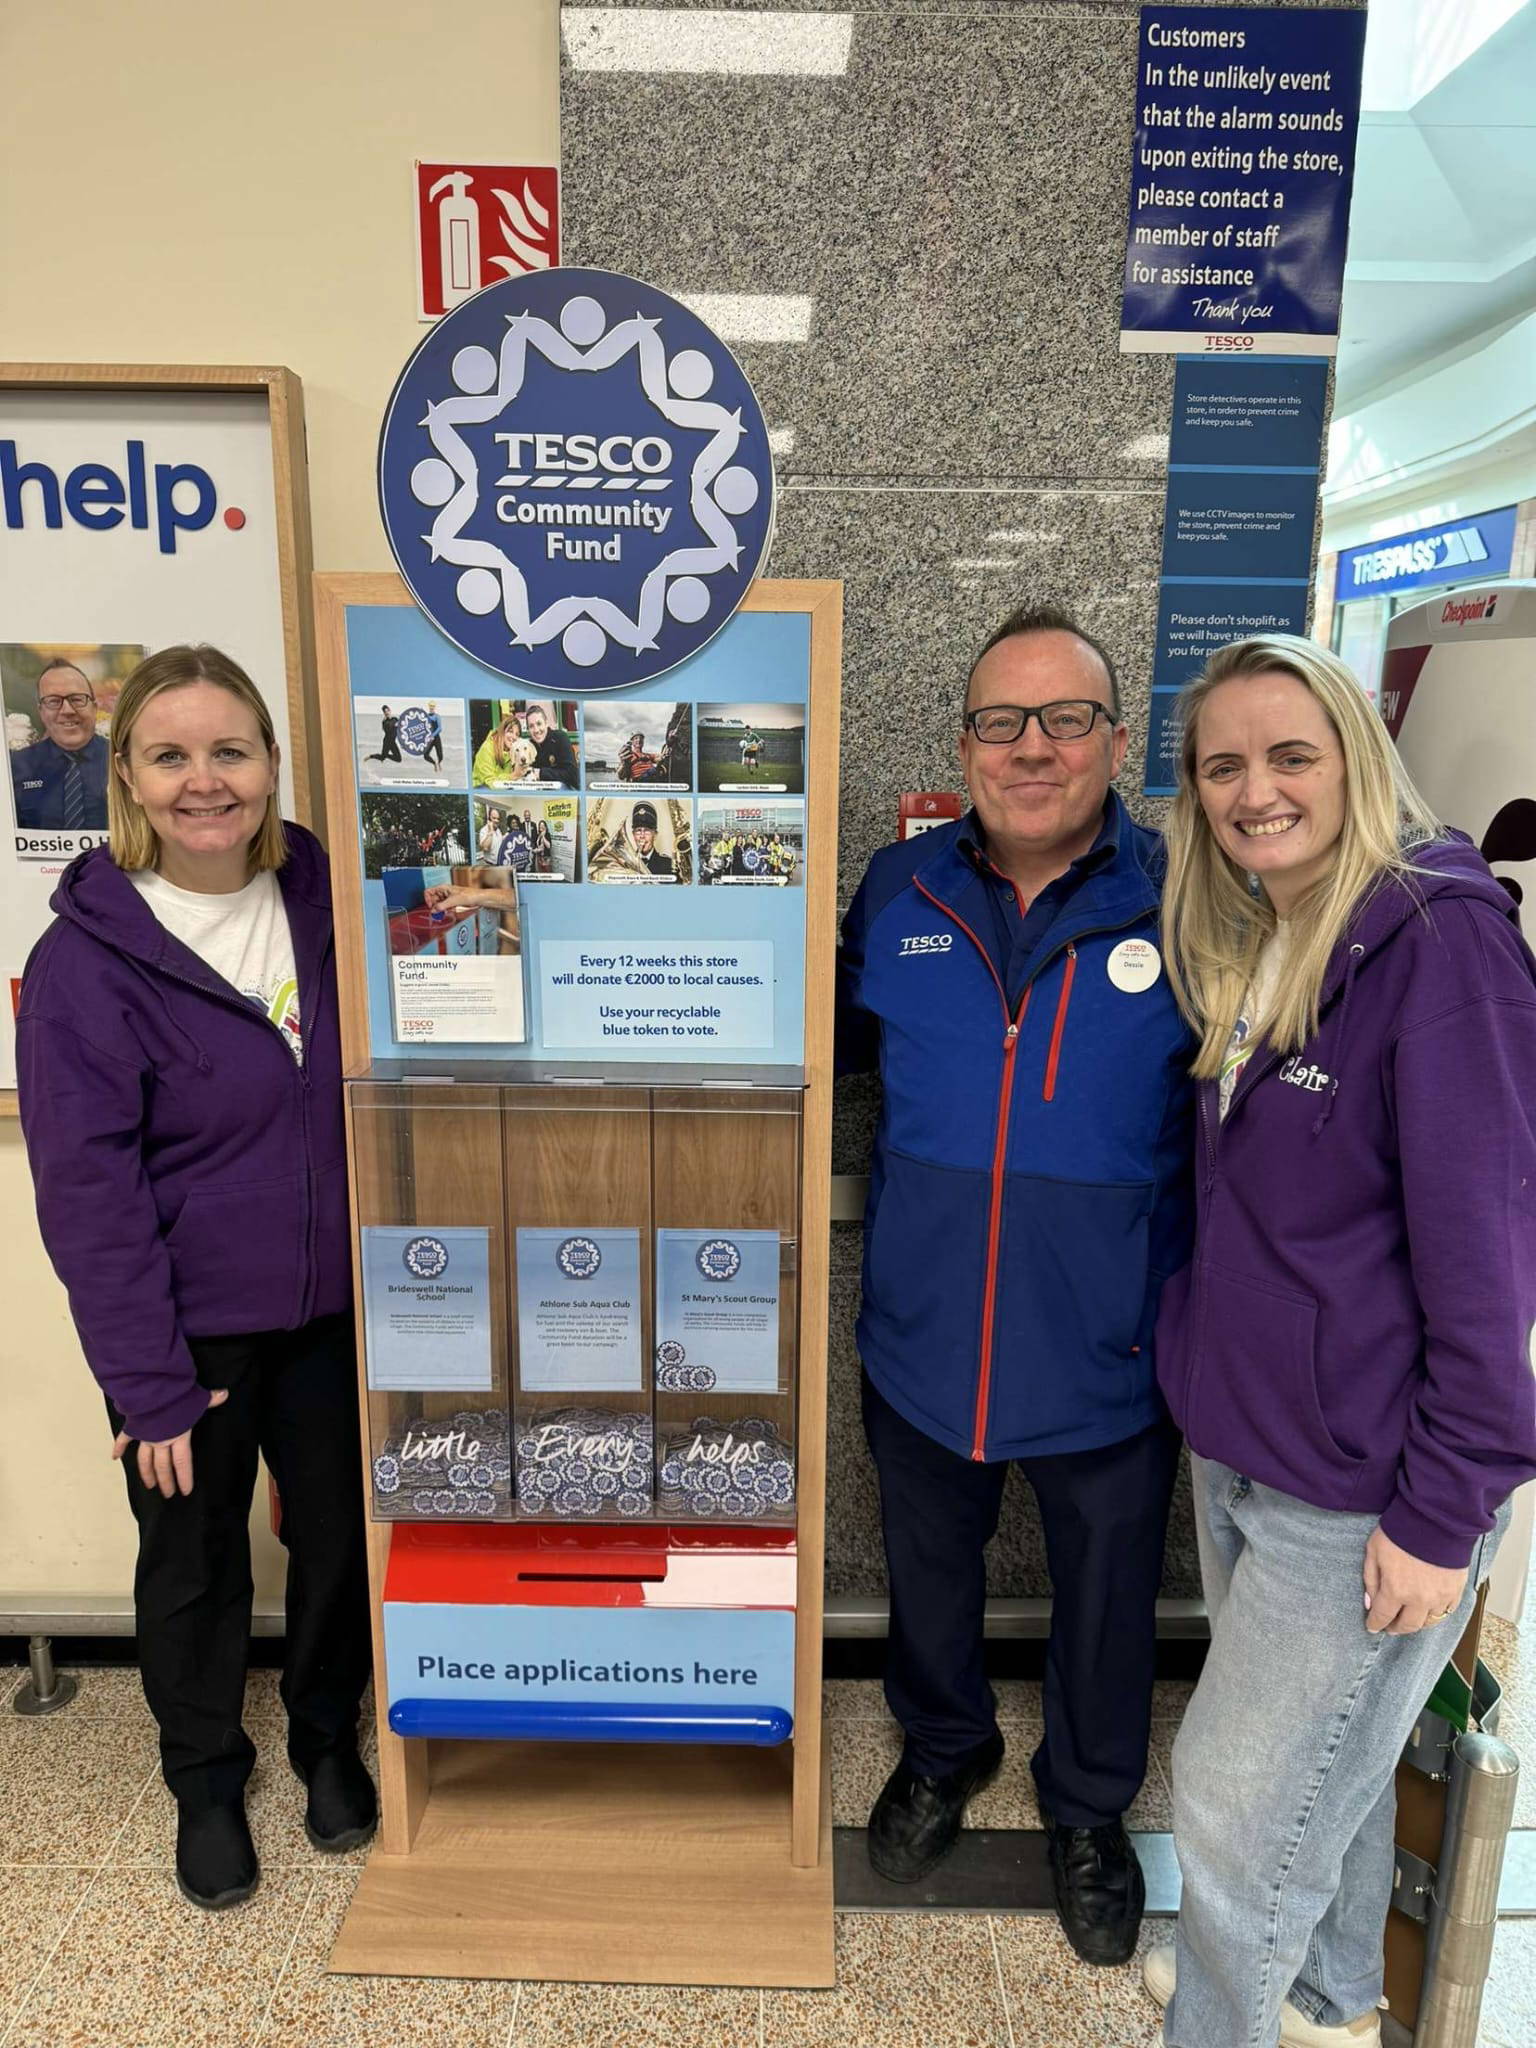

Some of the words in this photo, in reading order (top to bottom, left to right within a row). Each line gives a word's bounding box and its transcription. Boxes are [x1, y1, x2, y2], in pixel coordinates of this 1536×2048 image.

[1148, 24, 1245, 48] Customers
[1146, 64, 1162, 85] In
[1169, 65, 1198, 87] the
[1204, 67, 1275, 94] unlikely
[1280, 71, 1330, 91] event
[1143, 104, 1180, 127] that
[1186, 105, 1215, 128] the
[1220, 107, 1272, 129] alarm
[1278, 109, 1343, 131] sounds
[1141, 148, 1185, 170] upon
[1191, 147, 1252, 174] exiting
[1258, 148, 1288, 170] the
[1293, 151, 1344, 175] store,
[1138, 183, 1194, 209] please
[1200, 187, 1268, 209] contact
[1274, 192, 1283, 208] a
[1135, 224, 1208, 246] member
[1212, 225, 1232, 247] of
[1236, 226, 1280, 247] staff
[1133, 262, 1158, 283] for
[1161, 264, 1253, 285] assistance
[1192, 298, 1237, 320] Thank
[1241, 305, 1272, 324] you
[1205, 336, 1254, 346] TESCO
[1188, 394, 1207, 402] Store
[1209, 395, 1247, 403] detectives
[1249, 396, 1277, 405] operate
[1279, 396, 1286, 404] in
[1187, 407, 1207, 415] store,
[1209, 406, 1215, 414] in
[1217, 406, 1237, 415] order
[1248, 408, 1276, 417] prevent
[1278, 408, 1299, 416] crime
[1202, 418, 1220, 427] keep
[1236, 418, 1253, 426] safe.
[495, 433, 673, 473] TESCO
[0, 440, 246, 553] help.
[496, 495, 673, 533] Community
[1207, 510, 1228, 518] CCTV
[1228, 511, 1255, 520] images
[1214, 523, 1242, 532] prevent
[1177, 533, 1195, 542] keep
[1195, 534, 1209, 542] you
[547, 533, 622, 561] Fund
[1353, 537, 1436, 585] TRESPASS
[1442, 597, 1486, 625] Checkpoint
[1171, 614, 1205, 624] Please
[1207, 615, 1233, 624] don't
[1237, 615, 1276, 627] shoplift
[1278, 618, 1290, 626] as
[1169, 632, 1184, 640] we
[1187, 631, 1204, 640] will
[1207, 631, 1231, 640] have
[1168, 647, 1187, 658] you
[1190, 646, 1205, 655] for
[15, 836, 73, 851] Dessie
[79, 836, 93, 851] O
[901, 934, 952, 950] TESCO
[398, 960, 457, 970] Community
[580, 955, 615, 969] Every
[619, 956, 633, 966] 12
[636, 955, 676, 967] weeks
[680, 955, 703, 967] this
[706, 957, 738, 967] store
[400, 971, 428, 980] Fund.
[552, 974, 573, 984] will
[577, 974, 621, 985] donate
[625, 974, 664, 985] €2000
[668, 975, 680, 985] to
[684, 974, 713, 985] local
[717, 976, 763, 985] causes.
[600, 1006, 623, 1017] Use
[625, 1009, 654, 1019] your
[657, 1006, 721, 1019] recyclable
[603, 1025, 630, 1035] blue
[633, 1025, 669, 1035] token
[672, 1026, 684, 1035] to
[687, 1026, 718, 1035] vote.
[388, 1285, 433, 1293] Brideswell
[540, 1300, 570, 1308] Athlone
[573, 1300, 587, 1308] Sub
[590, 1301, 610, 1309] Aqua
[681, 1294, 691, 1302] St
[693, 1294, 722, 1304] Mary's
[723, 1295, 748, 1303] Scout
[750, 1295, 777, 1305] Group
[400, 1431, 481, 1461] little
[534, 1424, 634, 1472] Every
[687, 1433, 766, 1473] helps
[418, 1655, 495, 1679] Place
[505, 1659, 683, 1686] applications
[694, 1662, 757, 1684] here
